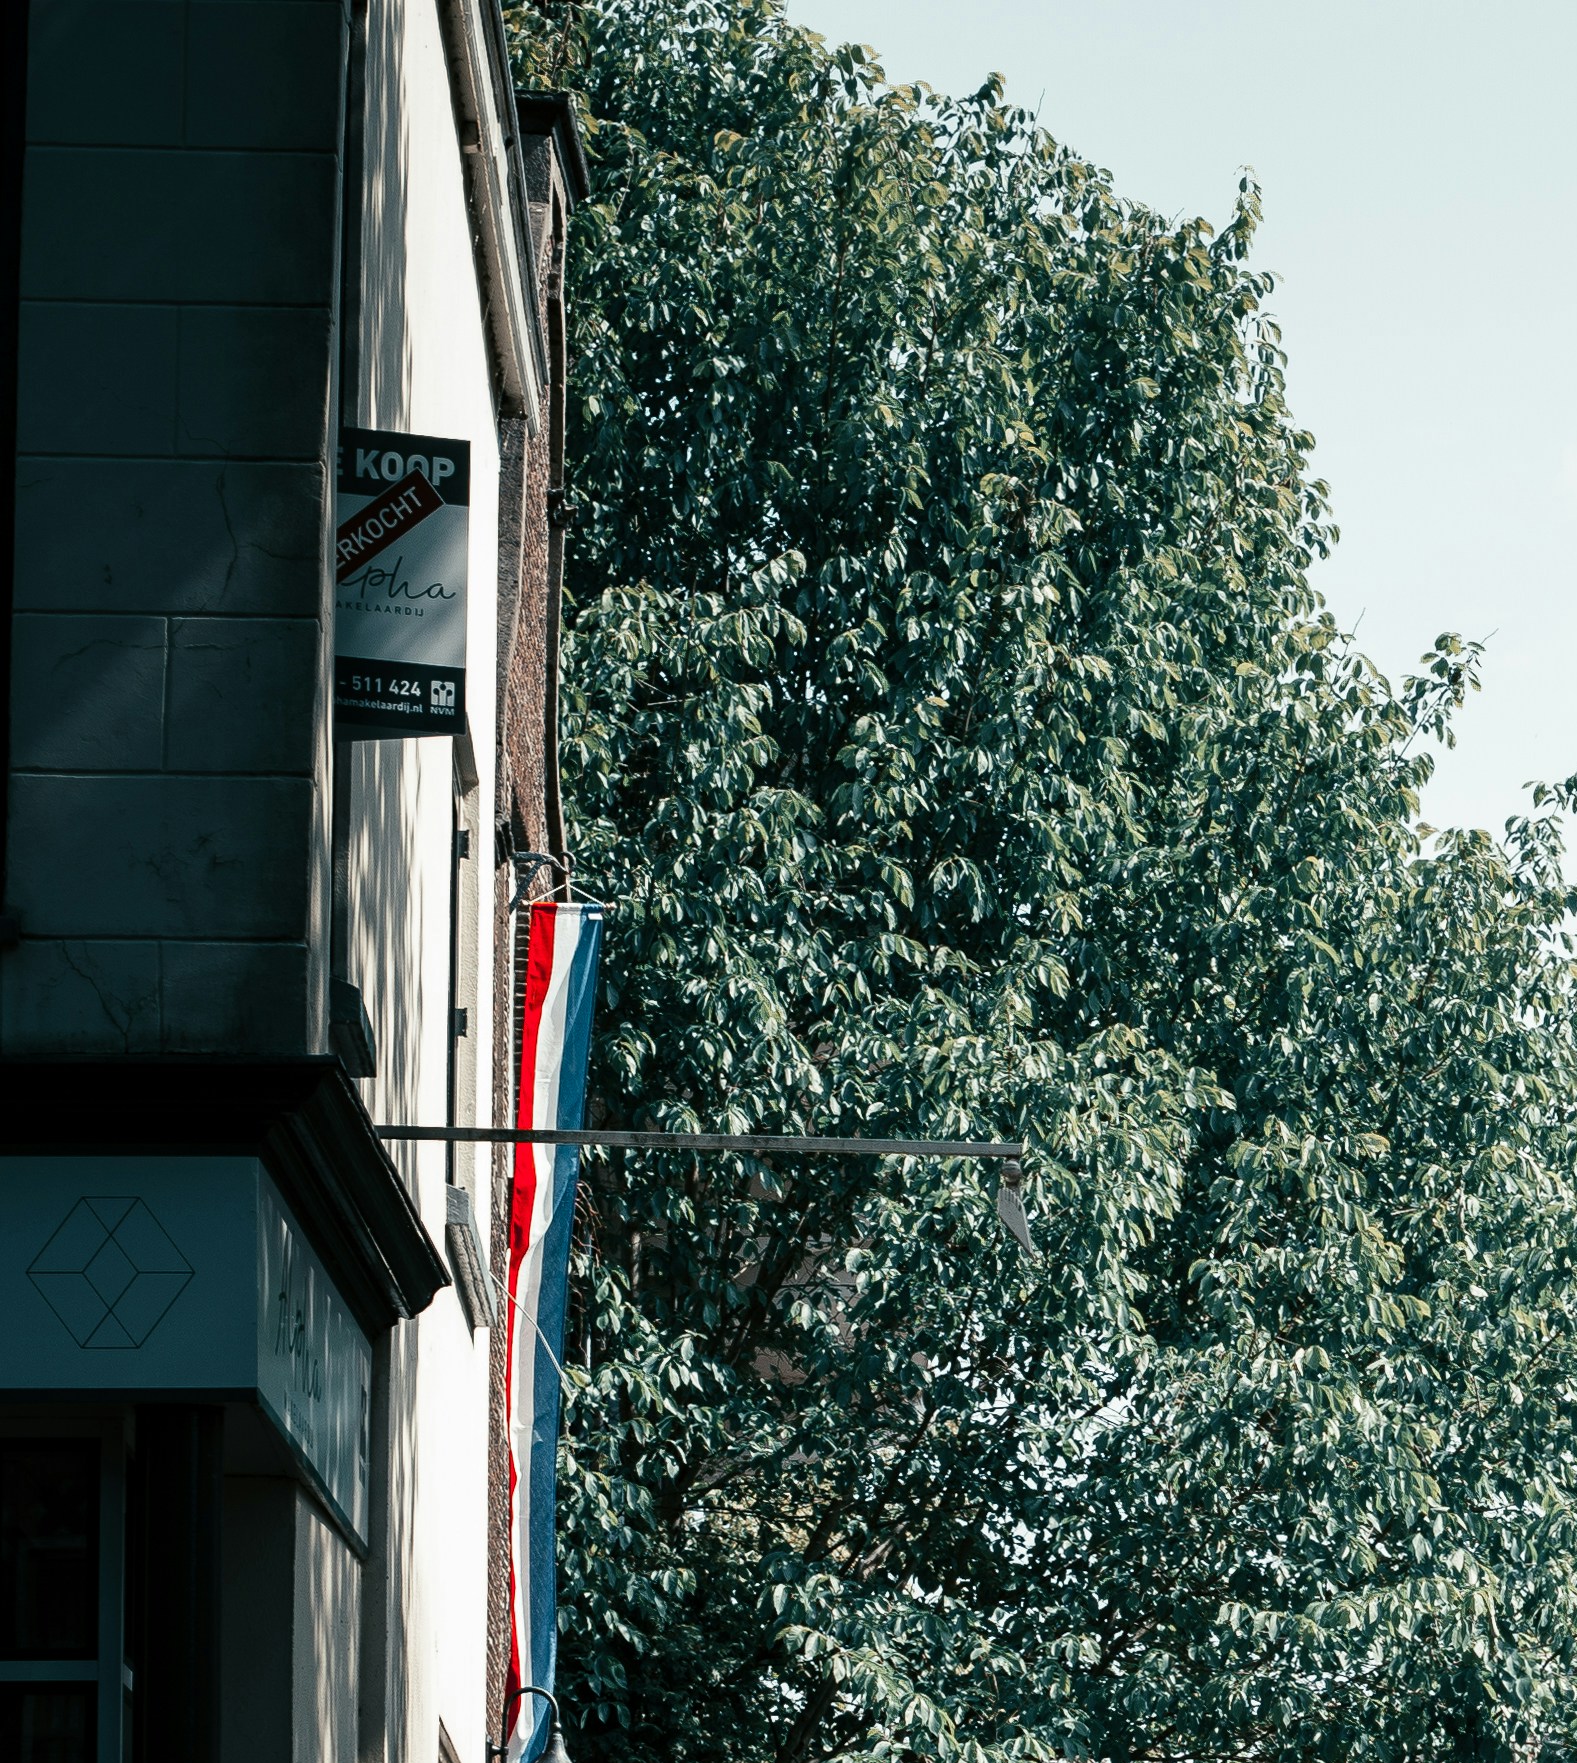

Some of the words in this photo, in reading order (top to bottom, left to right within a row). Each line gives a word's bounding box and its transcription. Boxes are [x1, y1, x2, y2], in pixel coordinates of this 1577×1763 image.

[355, 447, 456, 487] KOOP
[336, 485, 423, 568] RKOCHT
[341, 556, 457, 599] pha
[336, 600, 425, 617] AKELAARDIJ
[352, 674, 383, 694] 511
[388, 678, 422, 697] 424
[334, 695, 424, 714] hamakelaardij.nl
[429, 705, 455, 717] NVM
